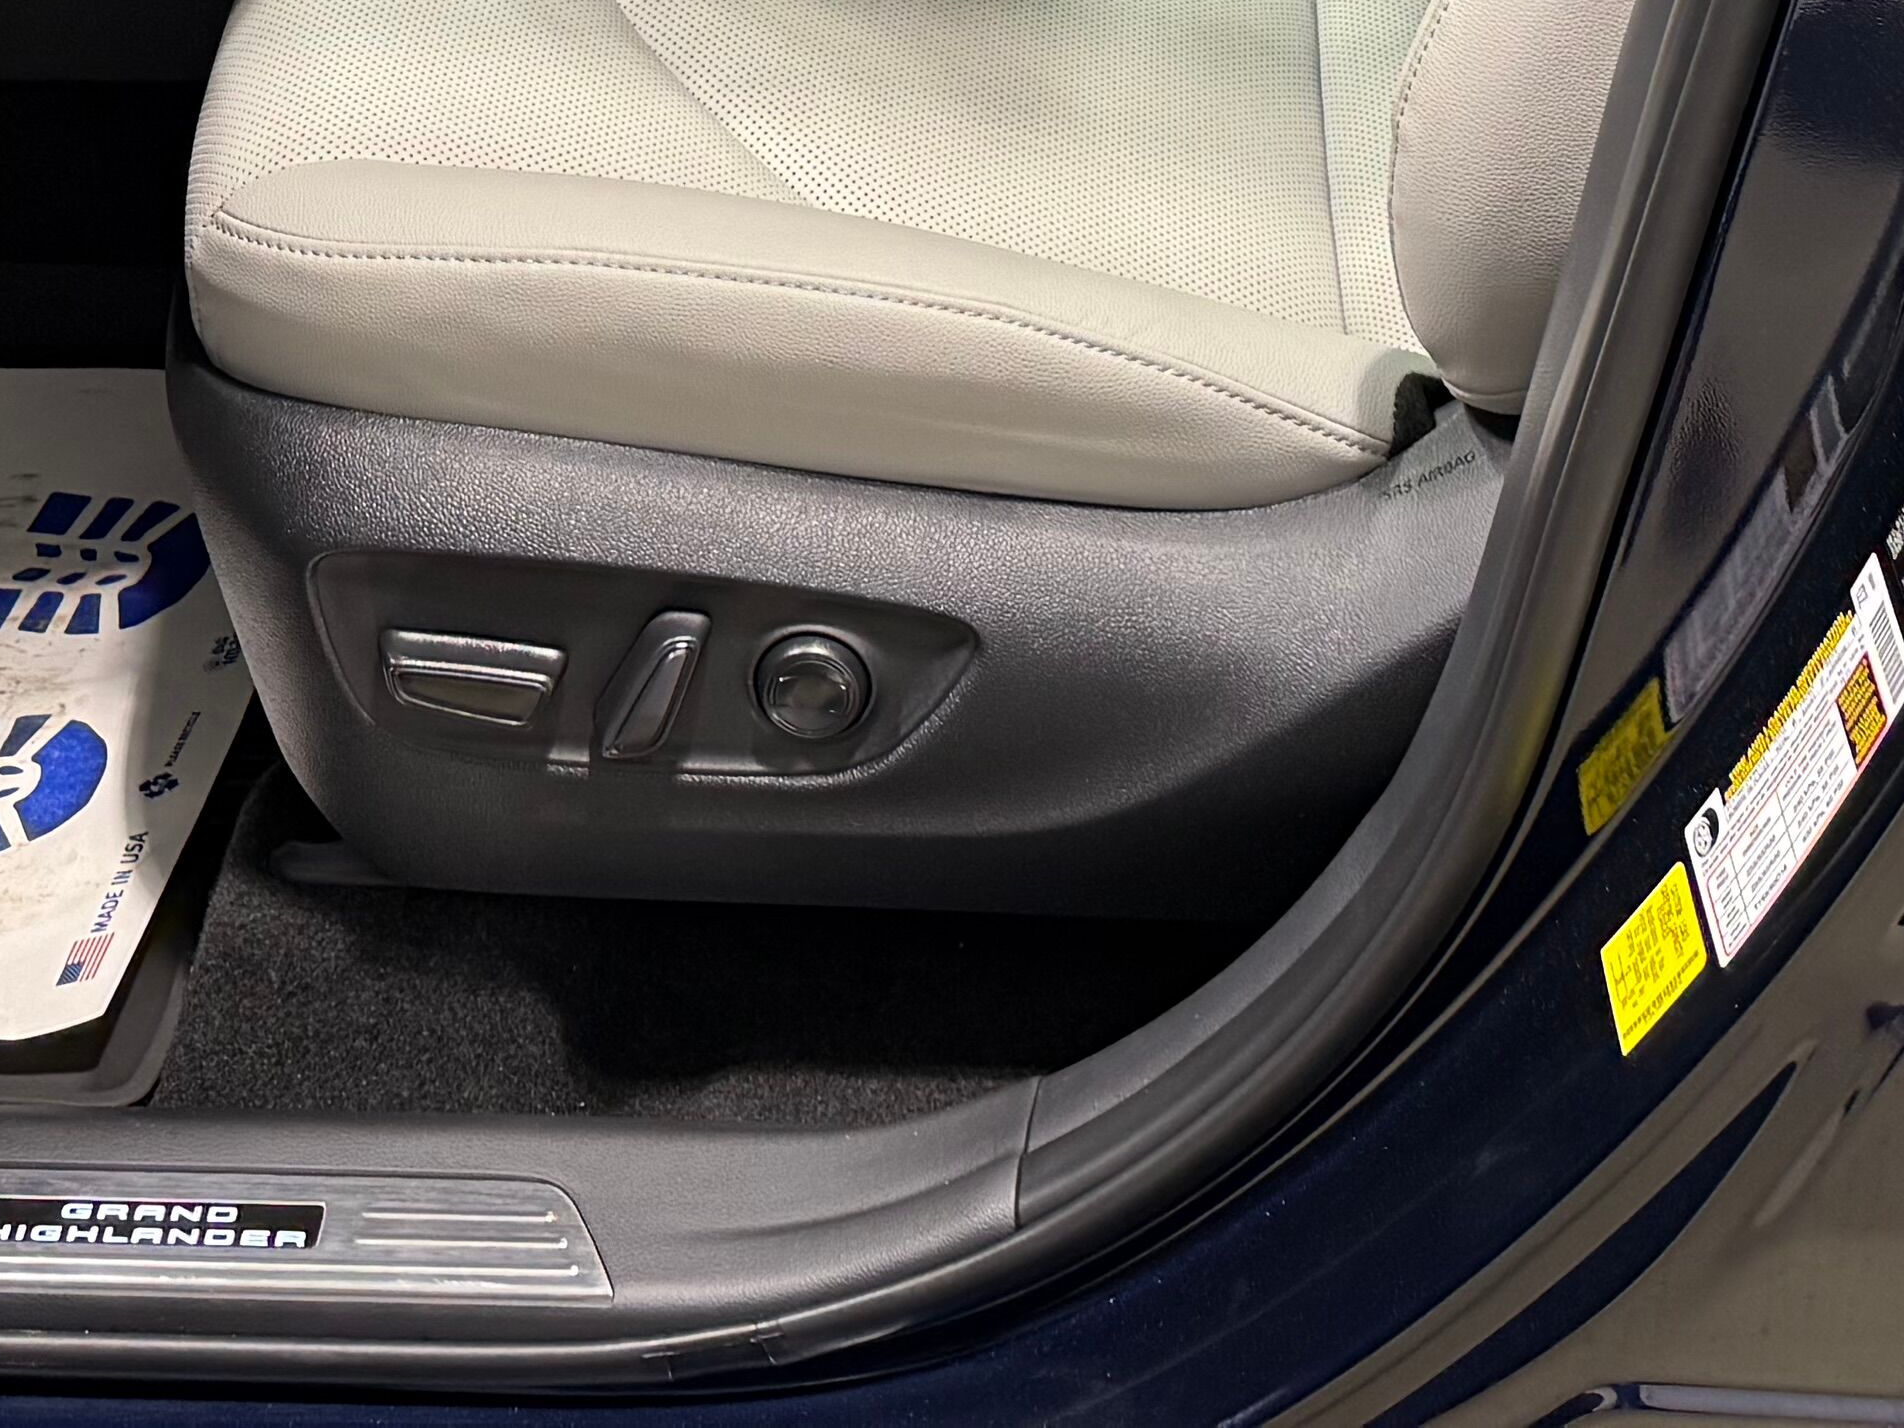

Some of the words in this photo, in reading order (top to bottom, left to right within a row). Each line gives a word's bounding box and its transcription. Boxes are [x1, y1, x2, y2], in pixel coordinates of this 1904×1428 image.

[1417, 450, 1476, 488] AIRBAG
[121, 831, 149, 865] USA
[112, 865, 133, 885] IN
[90, 888, 124, 932] MADE
[61, 1202, 239, 1224] GRAND
